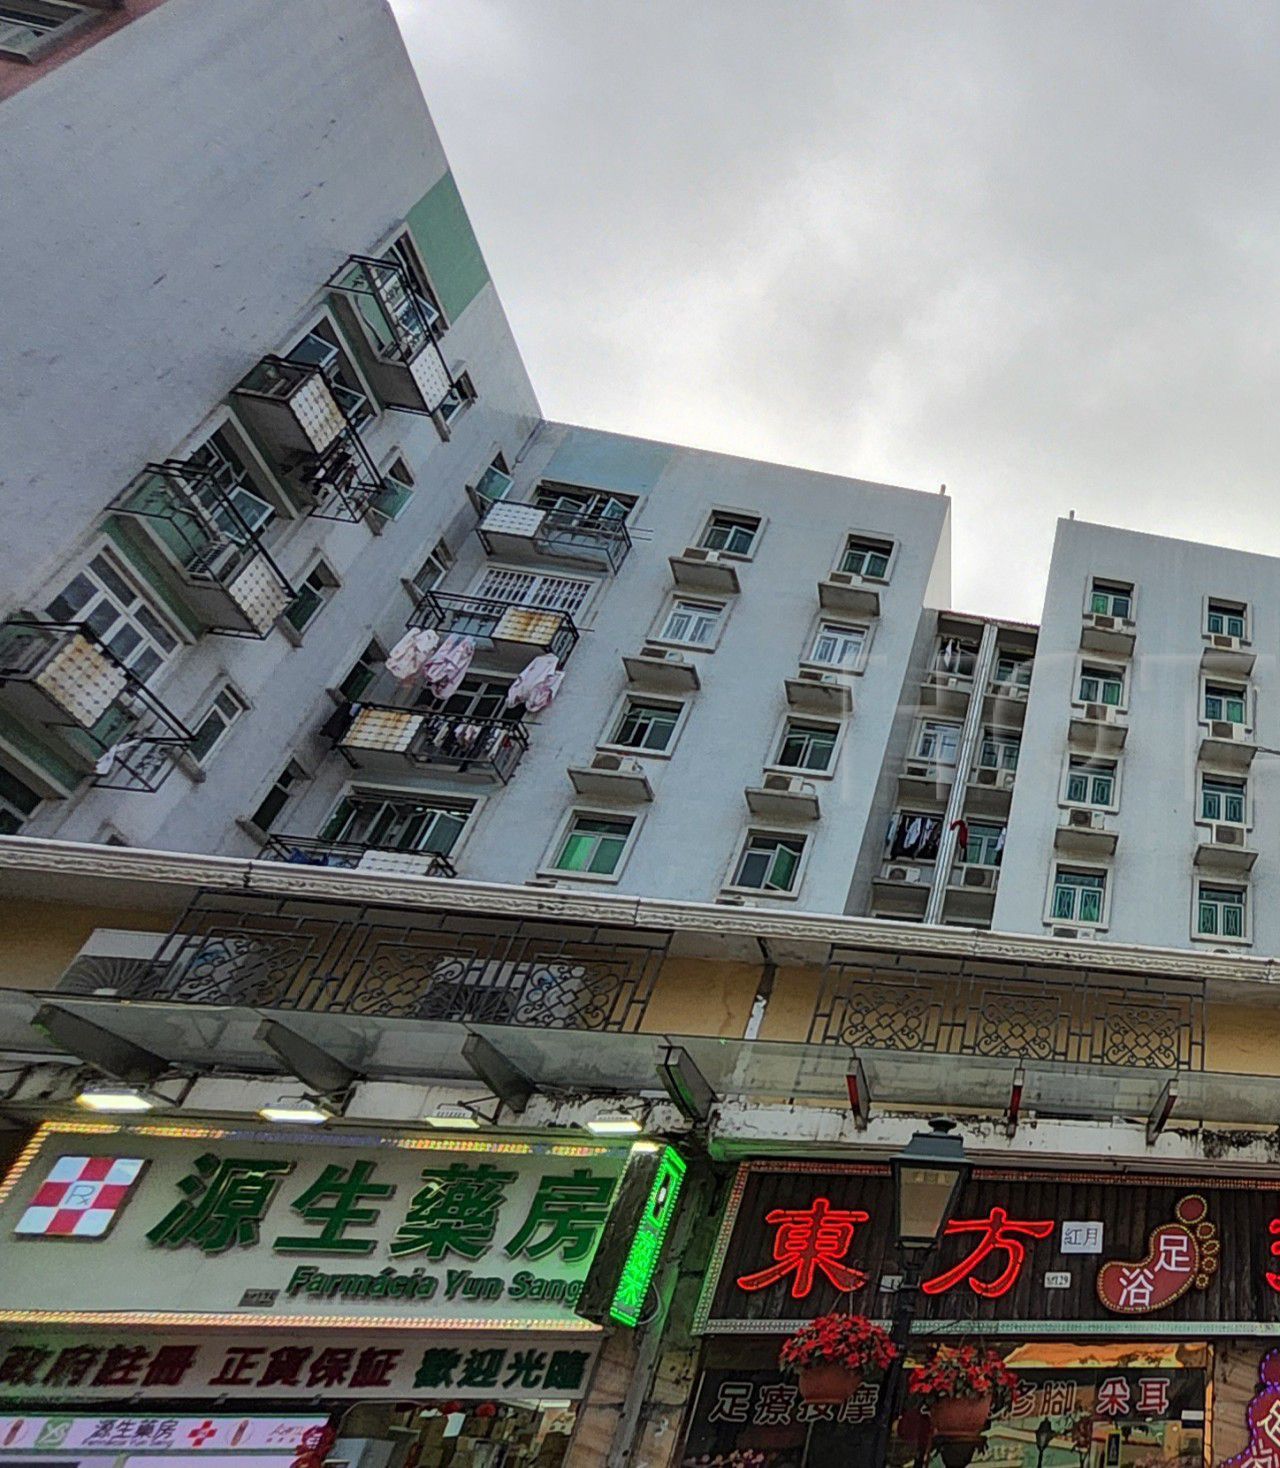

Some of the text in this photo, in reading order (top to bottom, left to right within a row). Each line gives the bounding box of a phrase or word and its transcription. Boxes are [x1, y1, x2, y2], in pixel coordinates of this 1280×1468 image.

[145, 1152, 616, 1264] 源生藥房
[285, 1265, 439, 1302] Farmácia
[444, 1268, 506, 1301] Yun
[507, 1270, 587, 1308] Sang
[207, 1345, 404, 1389] 正貨保証
[412, 1346, 592, 1390] 歡迎光臨
[1096, 1377, 1170, 1416] 采耳
